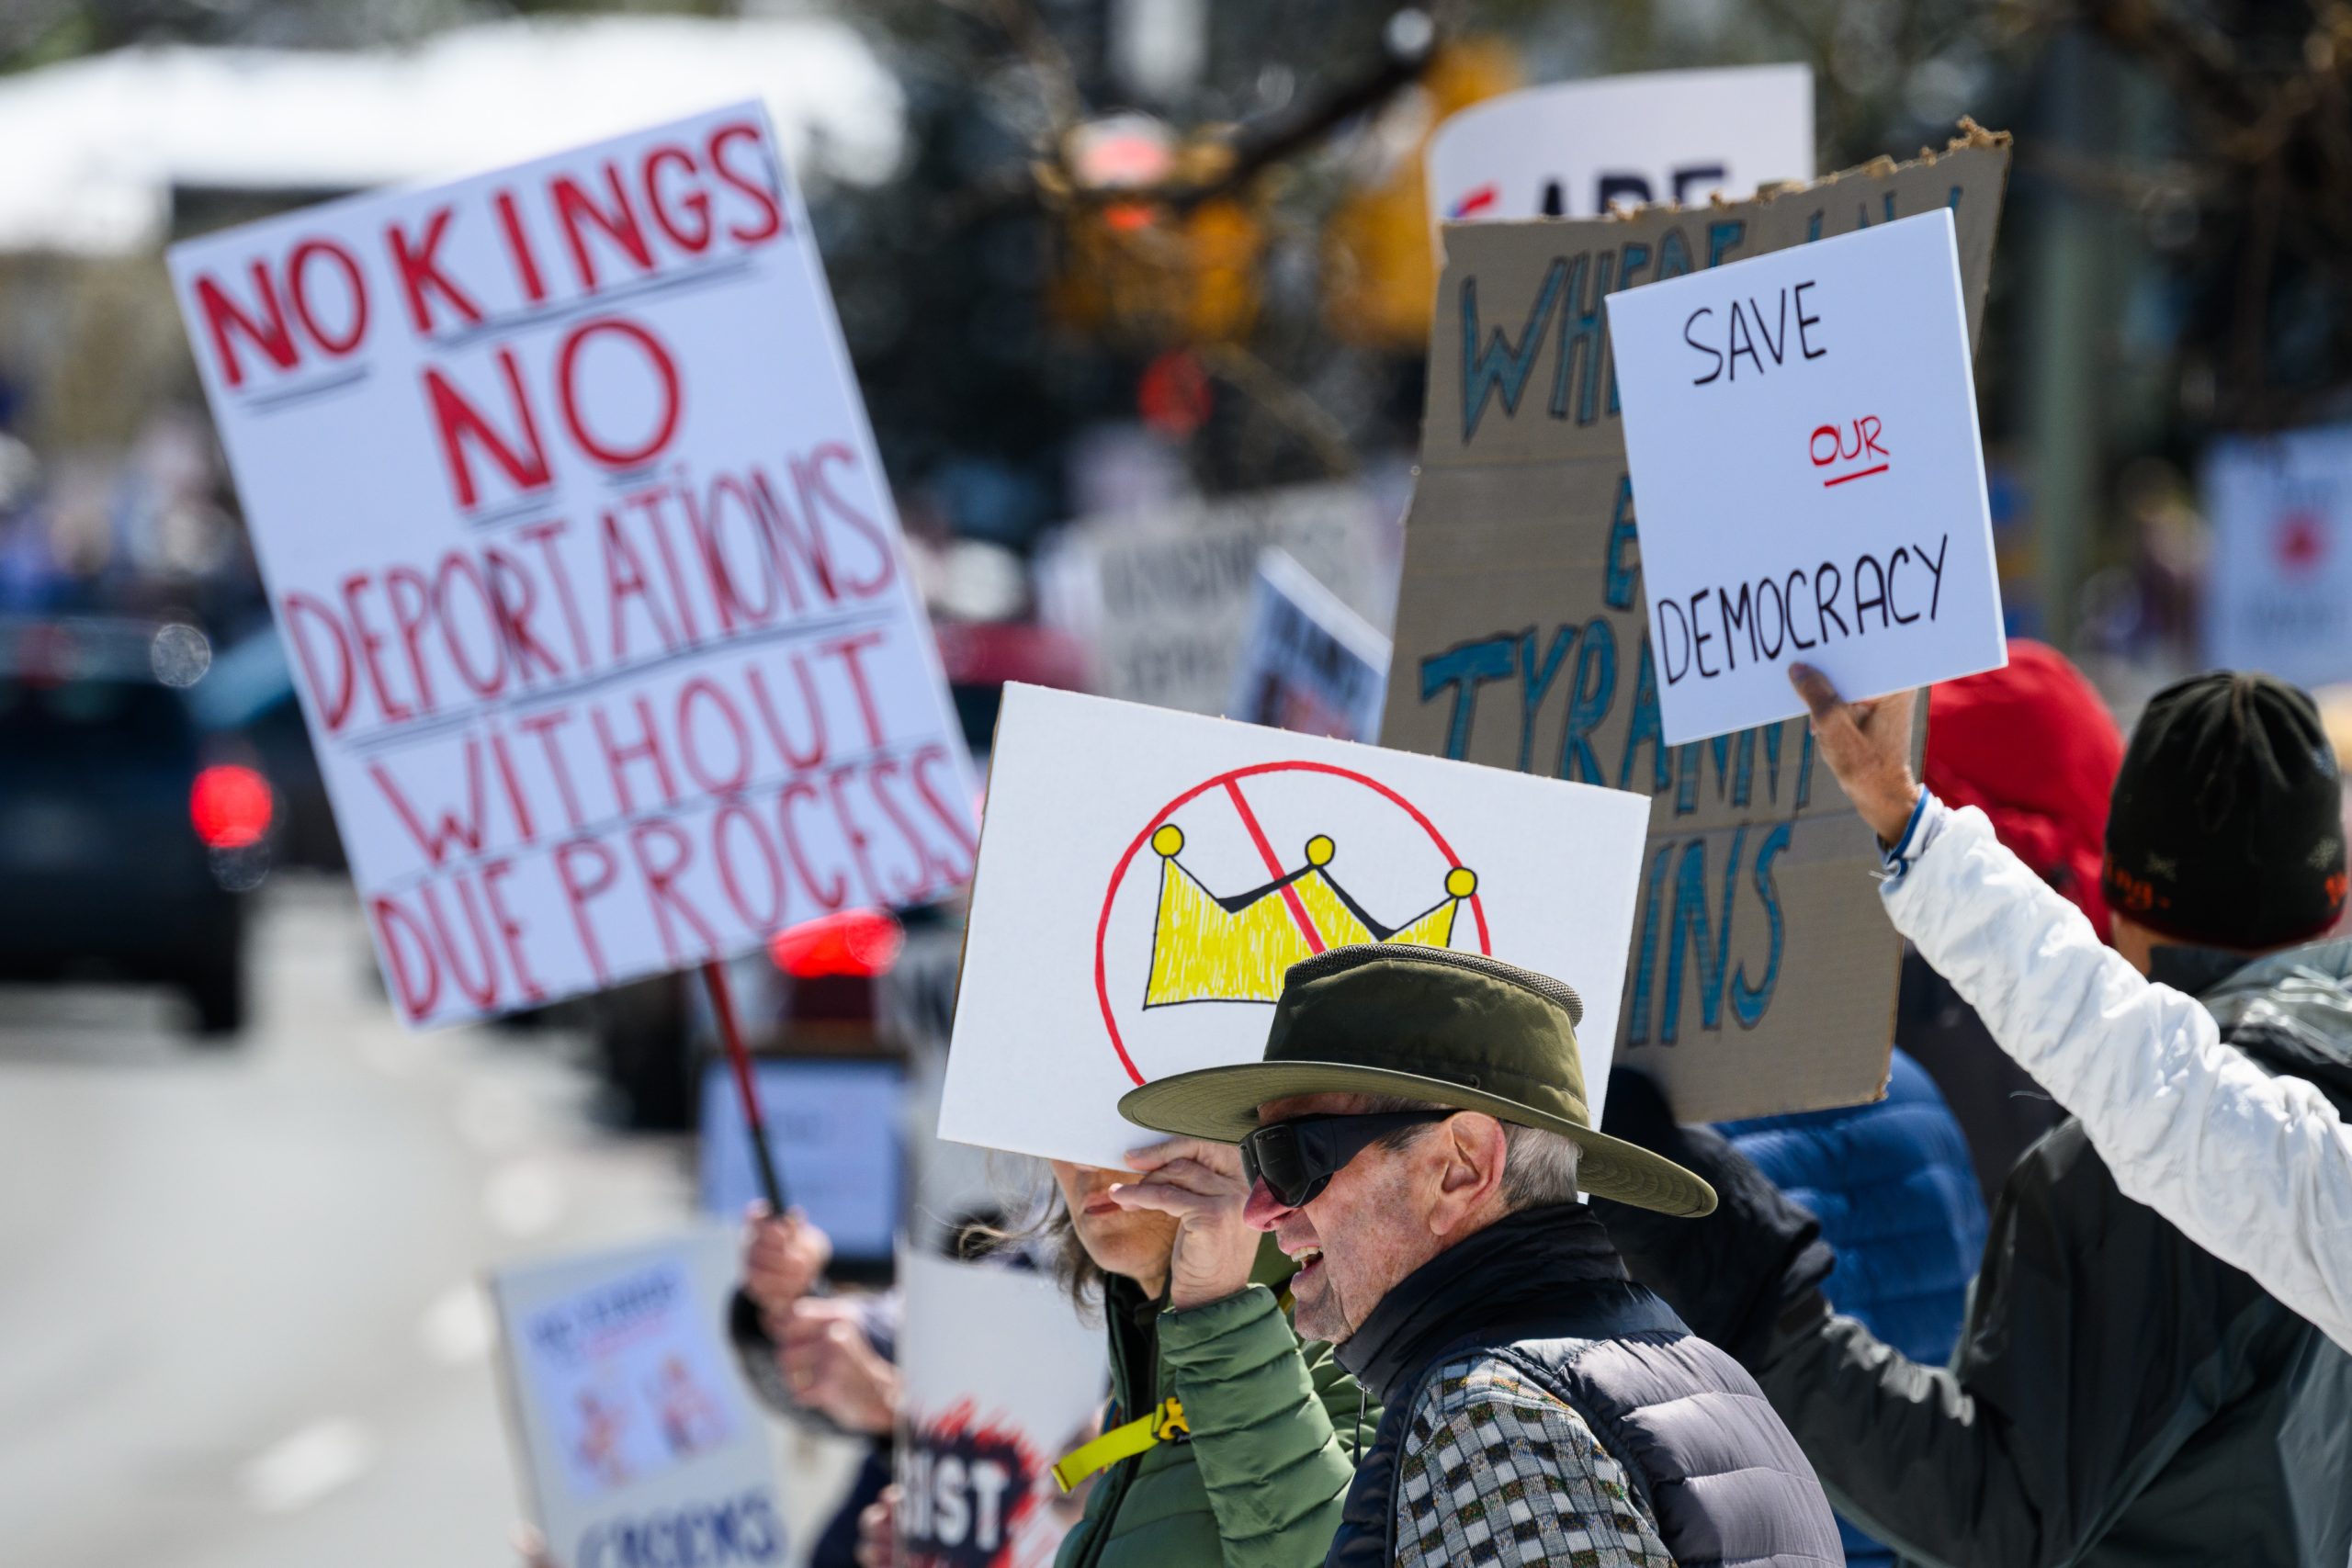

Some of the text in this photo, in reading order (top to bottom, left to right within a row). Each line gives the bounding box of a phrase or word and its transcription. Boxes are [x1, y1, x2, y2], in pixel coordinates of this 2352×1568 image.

[195, 120, 785, 389] NO KINGS
[1683, 279, 1828, 387] SAVE
[420, 314, 684, 512] NO
[1808, 414, 1891, 468] OUR
[1657, 533, 1949, 687] DEMOCRACY
[368, 631, 888, 866] WITHOUT
[369, 742, 978, 1022] DUE PROCESS
